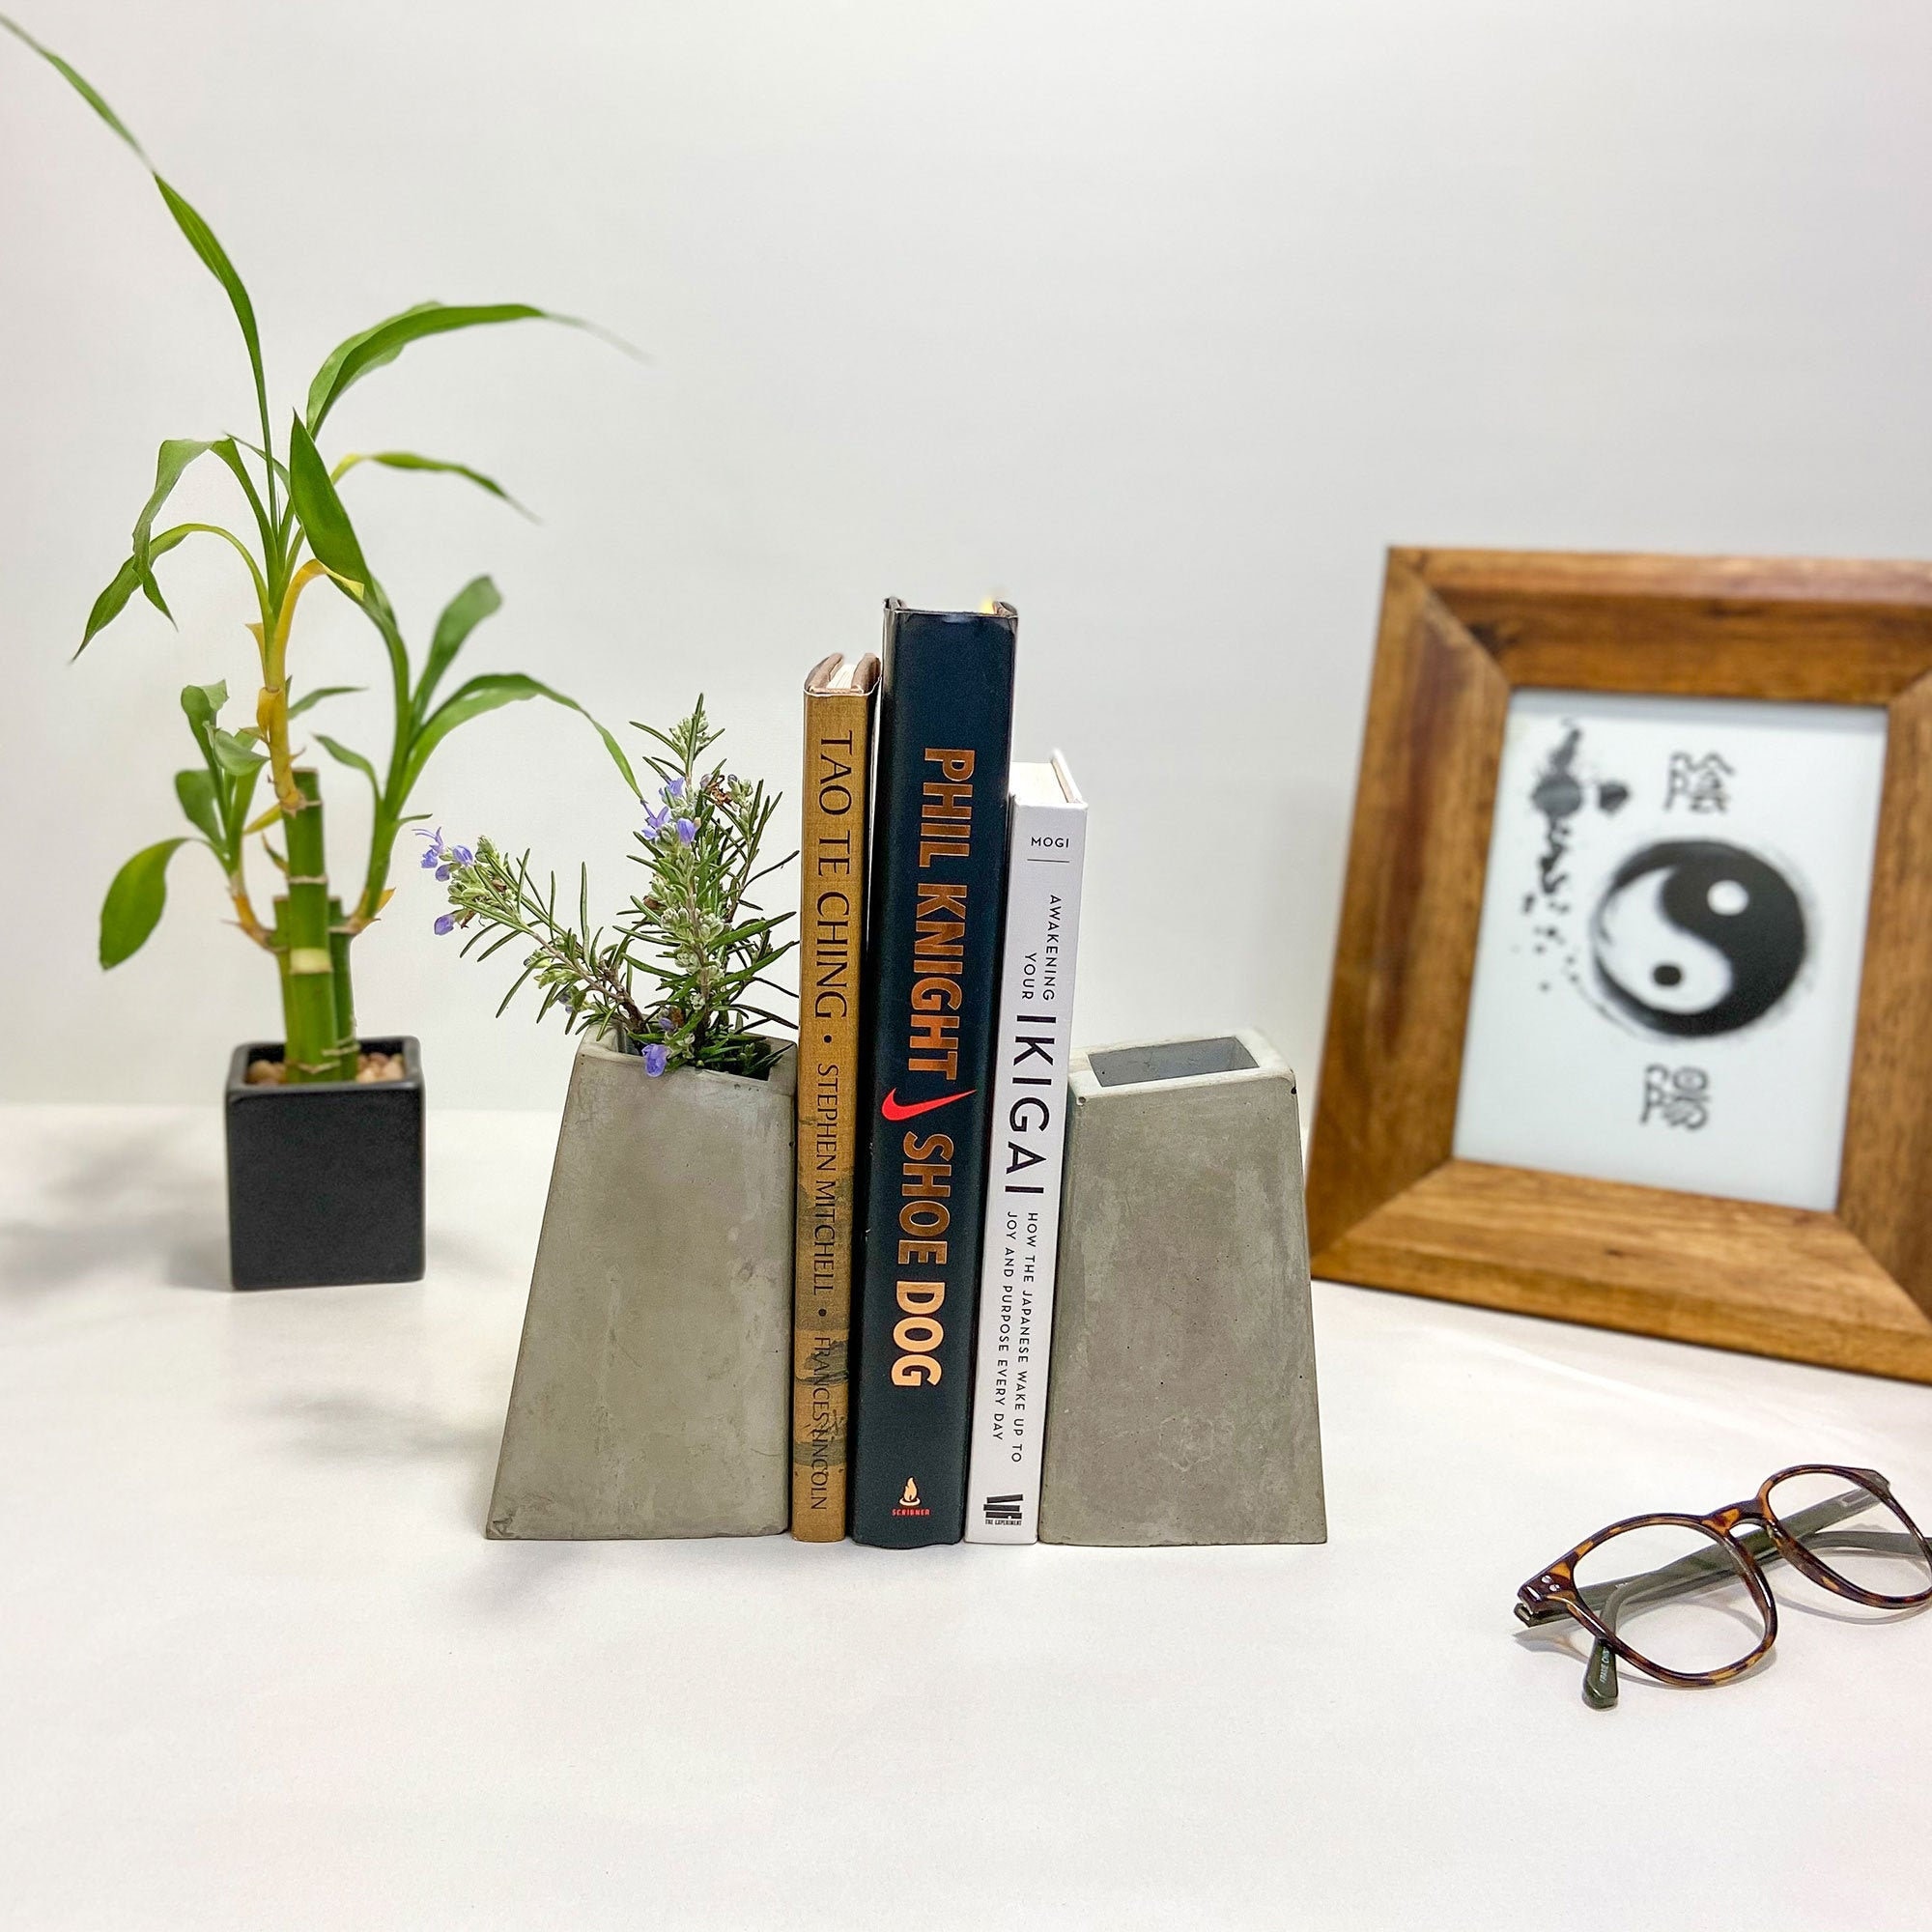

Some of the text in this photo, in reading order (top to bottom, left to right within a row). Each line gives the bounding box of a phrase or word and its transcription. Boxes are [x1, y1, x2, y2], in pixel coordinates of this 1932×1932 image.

[819, 729, 853, 816] TAO
[817, 829, 851, 878] TE
[1030, 836, 1070, 849] MOGI
[814, 890, 851, 1019] CHING
[1020, 952, 1037, 1001] YOUR
[1042, 894, 1061, 1002] AWAKENING
[815, 1063, 839, 1172] STEPHEN
[891, 747, 976, 1387] PHIL KNIGHT SHOE DOG
[1005, 1014, 1057, 1194] IKIGAI
[812, 1179, 837, 1296] MITCHELL
[812, 1336, 831, 1421] FRANCES
[992, 1210, 1018, 1441] JOY AND PURPOSE EVERY DAY
[1011, 1212, 1038, 1463] HOW THE JAPANESE WAKE UP TO
[892, 1508, 930, 1517] SCRIBNER
